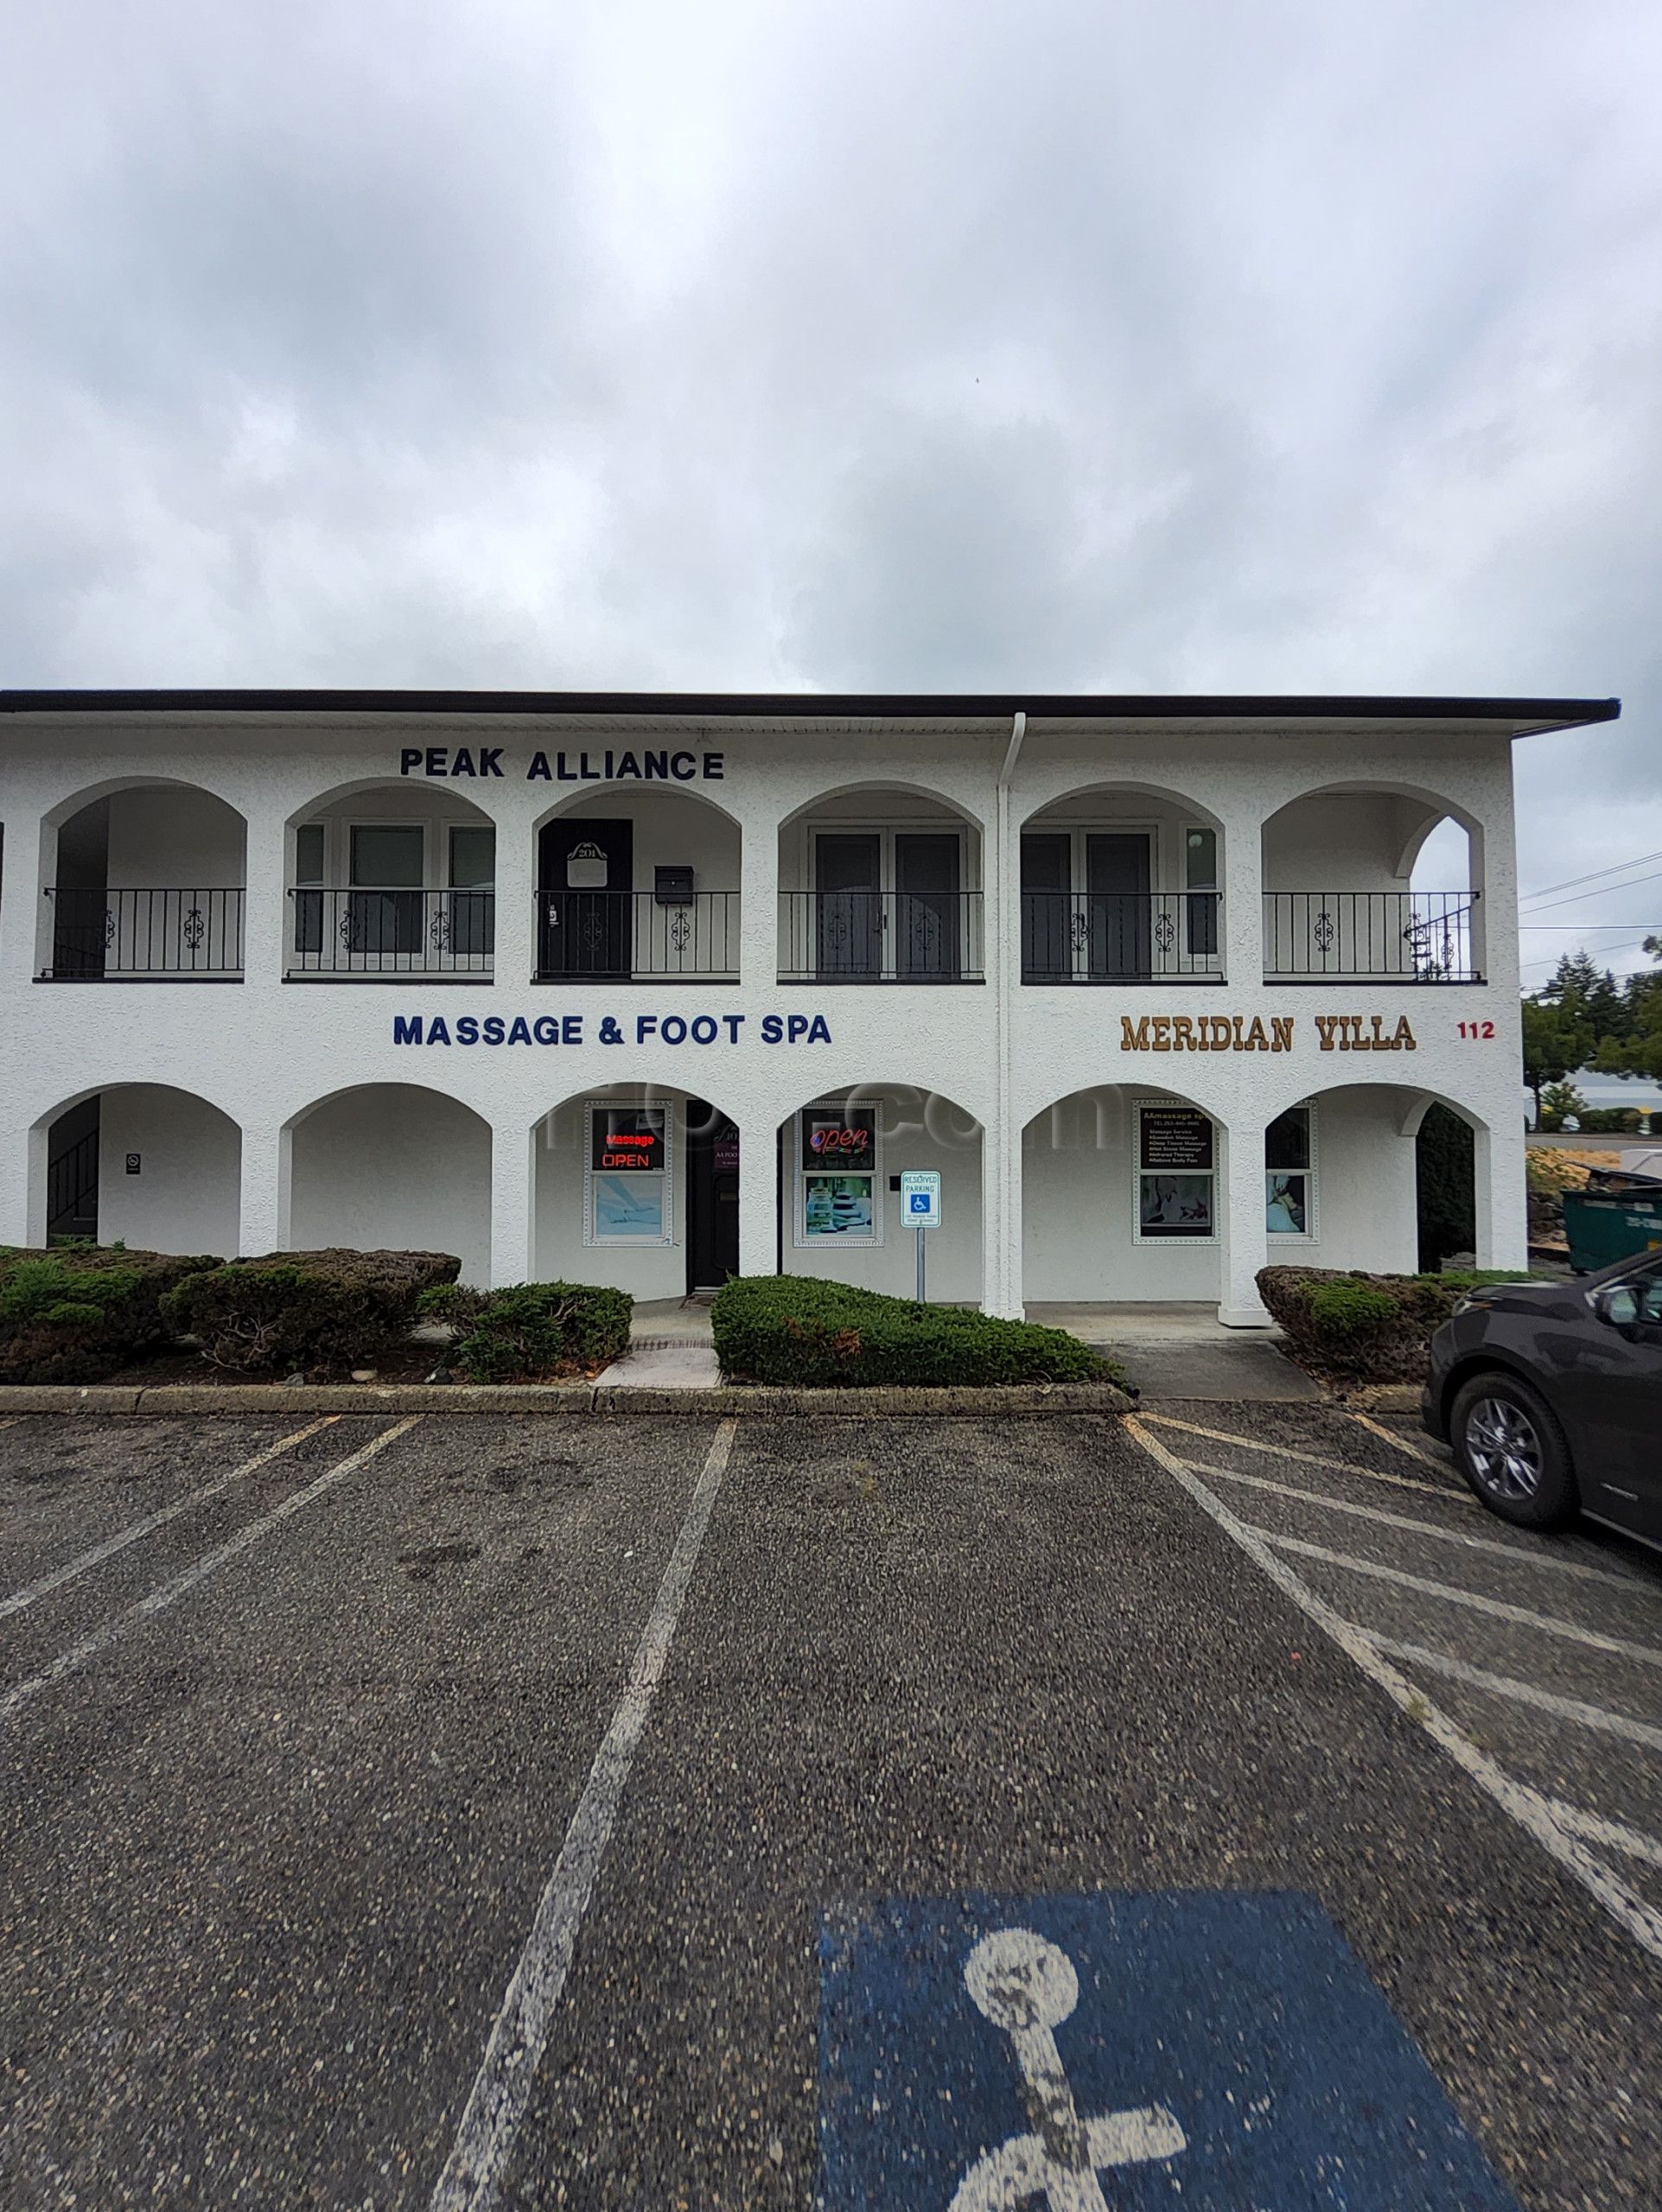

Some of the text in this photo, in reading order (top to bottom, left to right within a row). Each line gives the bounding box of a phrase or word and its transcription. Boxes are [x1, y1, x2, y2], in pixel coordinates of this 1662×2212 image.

[400, 747, 724, 781] PEAK ALLIANCE
[578, 849, 596, 858] 201
[393, 1014, 832, 1046] MASSAGE & FOOT SPA
[1120, 1014, 1417, 1052] MERIDIAN VILLA
[1456, 1020, 1495, 1039] 112
[606, 1135, 654, 1147] Massage
[810, 1128, 869, 1154] open
[602, 1154, 649, 1166] OPEN
